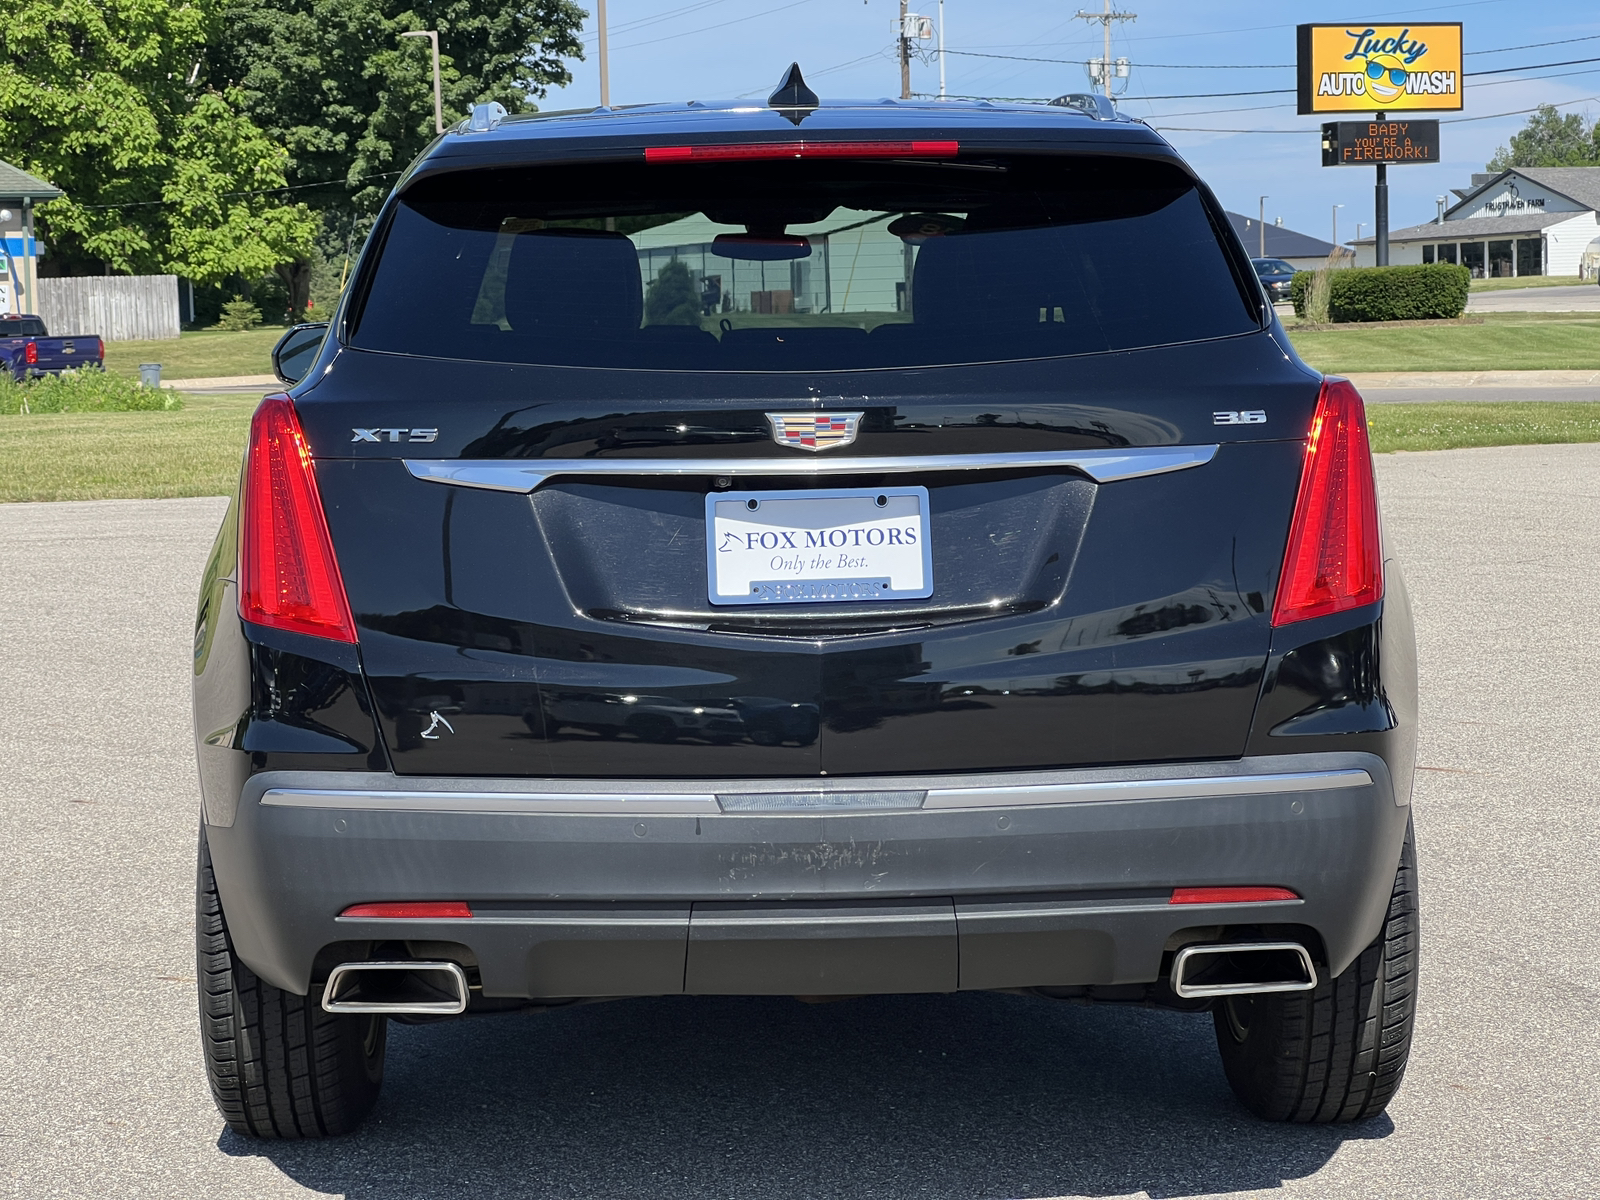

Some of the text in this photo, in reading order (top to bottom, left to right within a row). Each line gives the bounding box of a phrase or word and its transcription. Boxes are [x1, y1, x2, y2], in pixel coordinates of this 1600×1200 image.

[1344, 28, 1428, 64] Lucky
[1317, 71, 1456, 96] AUTO WASH
[1368, 123, 1409, 136] BABY
[1354, 137, 1412, 148] YOU'RE A
[1343, 146, 1429, 160] FIREWORK!
[1527, 198, 1545, 207] FARM
[351, 428, 439, 442] XT5
[745, 527, 917, 549] FOX MOTORS
[770, 553, 869, 574] Only the Best.
[776, 582, 880, 599] FOX MOTORS
